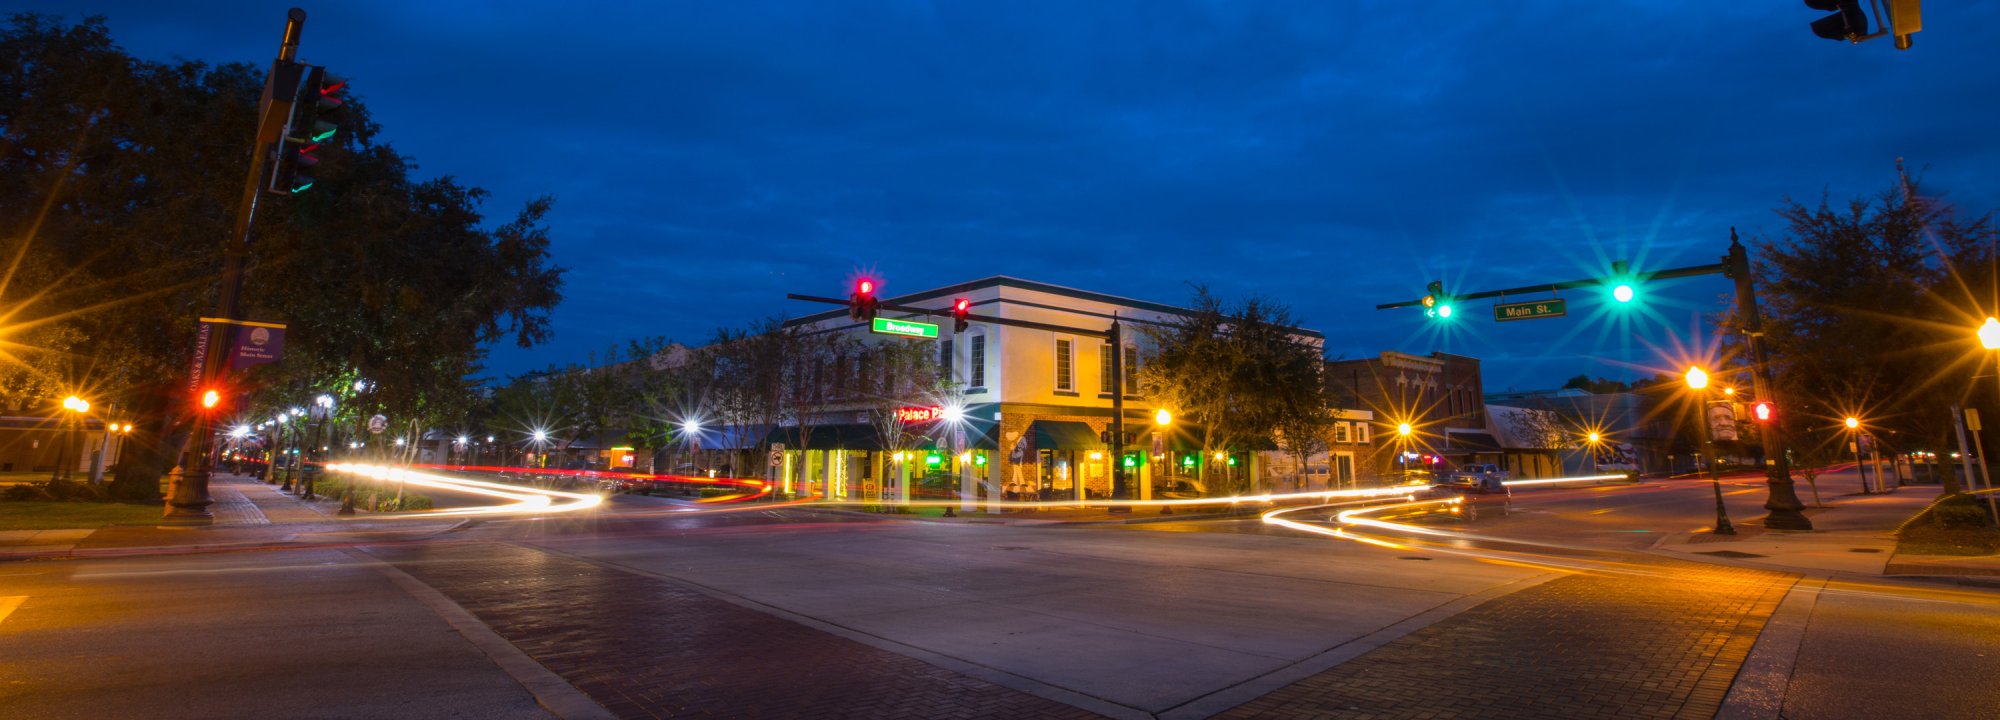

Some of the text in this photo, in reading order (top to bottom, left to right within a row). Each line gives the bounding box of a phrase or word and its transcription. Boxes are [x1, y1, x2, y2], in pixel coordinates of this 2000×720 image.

[1506, 304, 1552, 317] Main St.
[886, 321, 925, 336] Broadway
[195, 324, 209, 361] AZALEAS
[190, 369, 201, 392] OAKS
[898, 408, 930, 421] Palace
